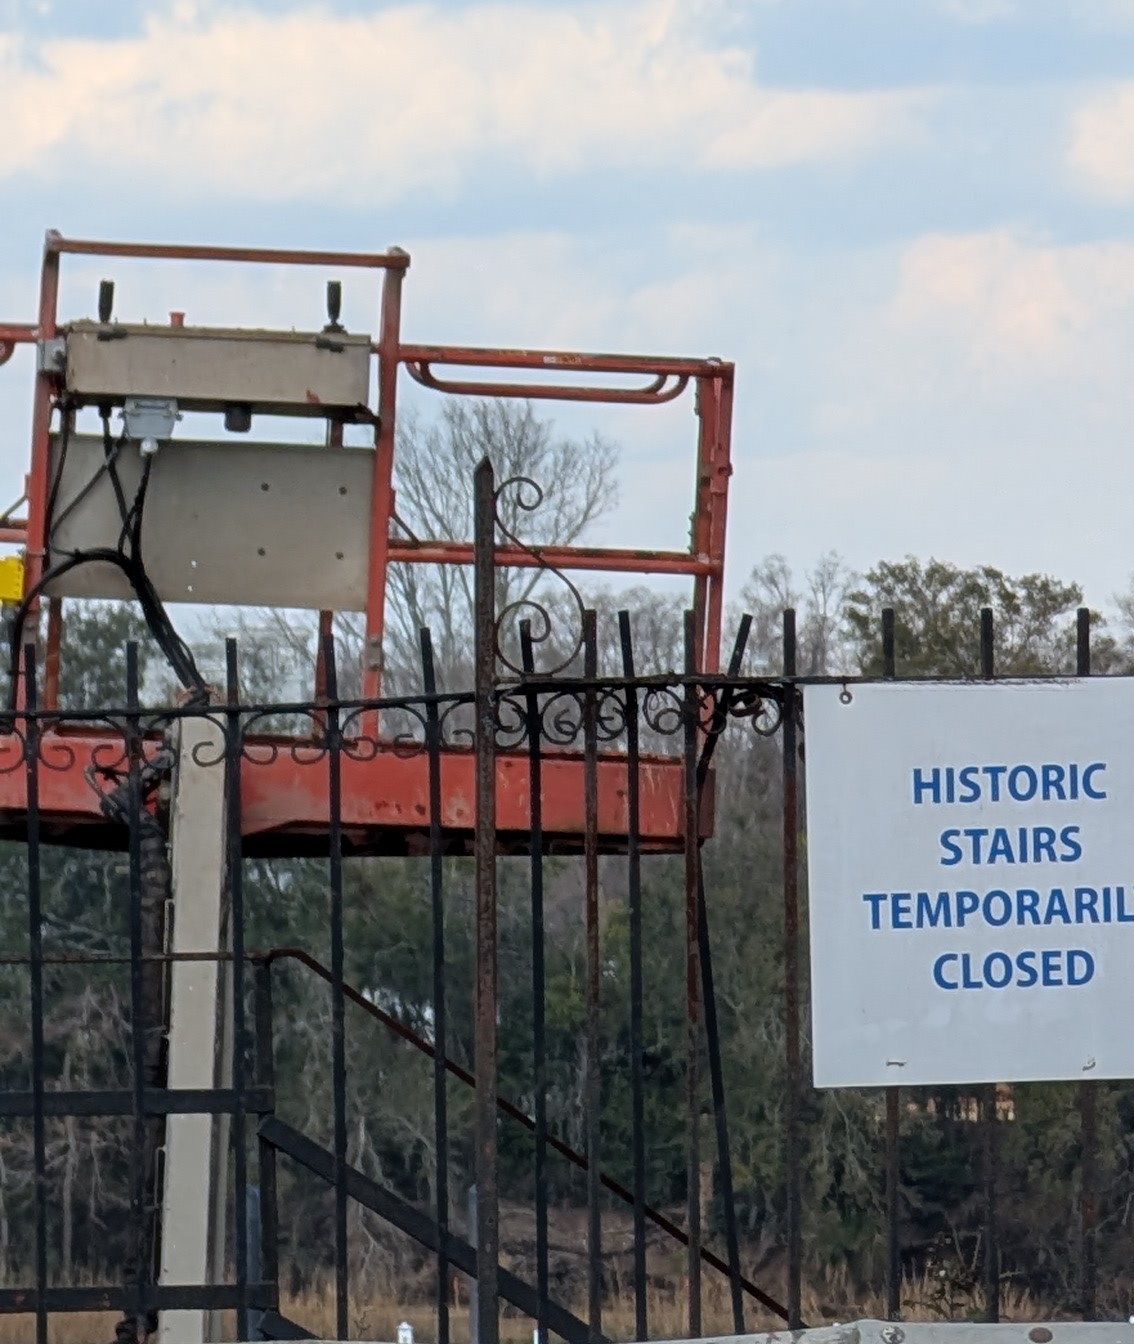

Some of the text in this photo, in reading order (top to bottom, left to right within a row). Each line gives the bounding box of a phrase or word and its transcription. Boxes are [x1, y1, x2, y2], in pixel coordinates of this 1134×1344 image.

[913, 763, 1107, 803] HISTORIC
[940, 826, 1082, 865] STAIRS
[933, 950, 1095, 989] CLOSED
